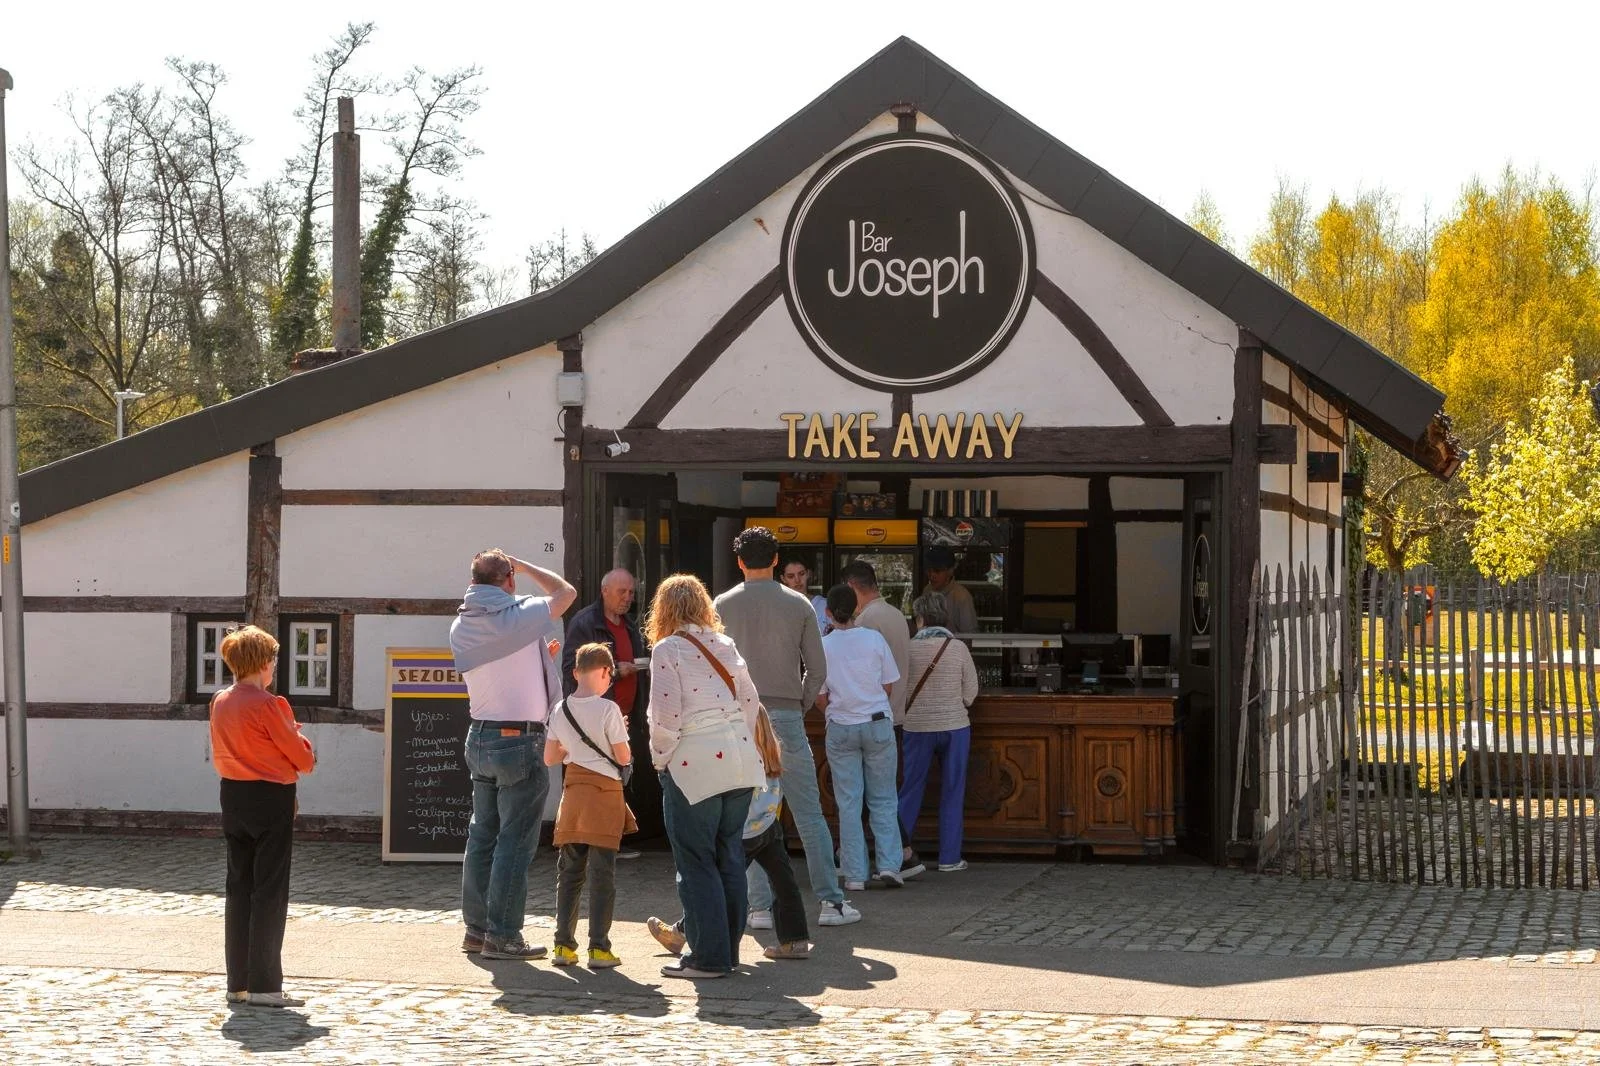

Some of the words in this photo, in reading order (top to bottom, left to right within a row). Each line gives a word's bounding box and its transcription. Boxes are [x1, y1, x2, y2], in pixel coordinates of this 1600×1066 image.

[862, 221, 892, 252] Bar
[828, 210, 985, 319] Joseph
[780, 412, 881, 459] TAKE
[892, 412, 1024, 459] AWAY
[544, 542, 555, 552] 26
